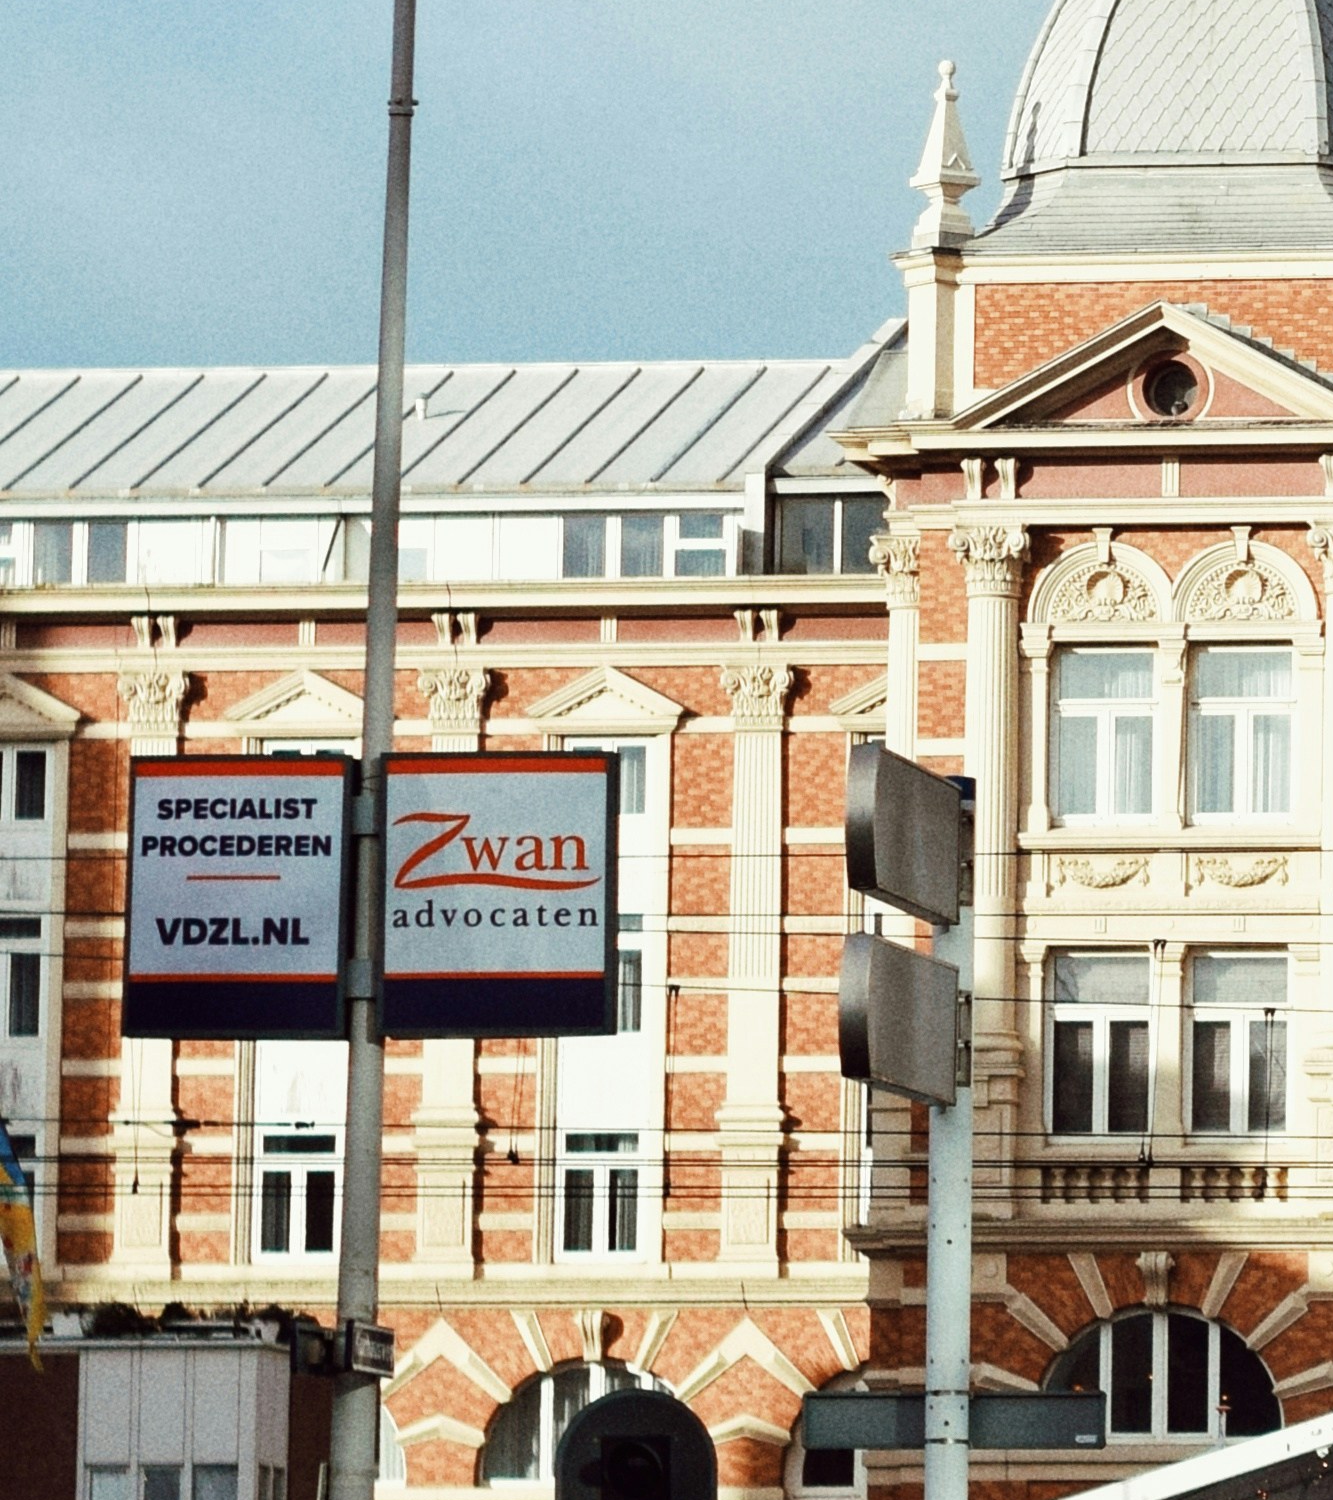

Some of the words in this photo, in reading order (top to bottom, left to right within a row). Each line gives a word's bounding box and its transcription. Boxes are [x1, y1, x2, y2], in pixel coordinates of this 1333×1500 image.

[157, 798, 318, 821] SPECIALIST
[141, 835, 332, 857] PROCEDEREN
[392, 812, 602, 891] Zwan
[392, 899, 599, 928] advocaten
[156, 917, 310, 946] VDZL.NL
